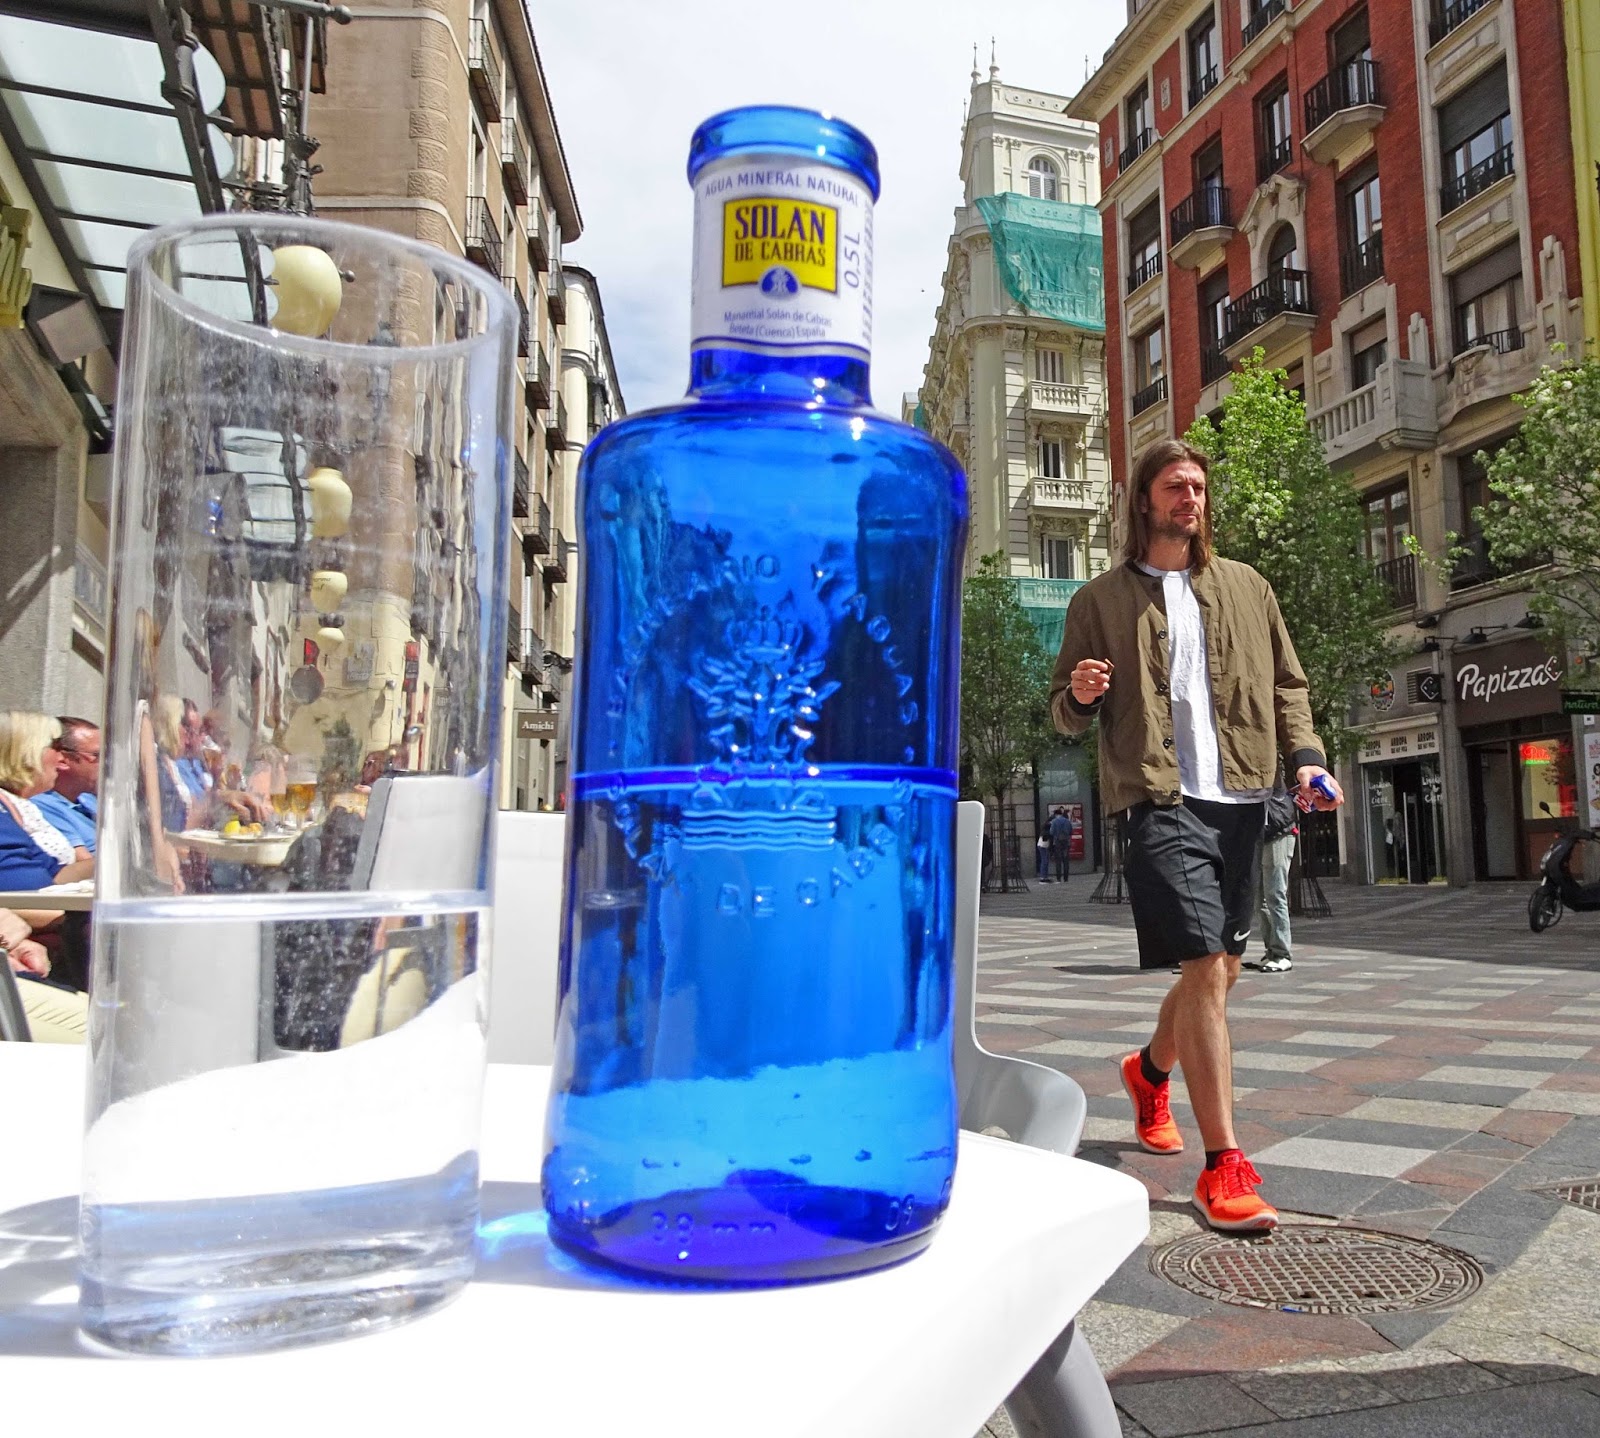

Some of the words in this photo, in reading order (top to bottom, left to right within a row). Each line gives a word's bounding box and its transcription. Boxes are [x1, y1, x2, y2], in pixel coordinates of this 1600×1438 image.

[705, 176, 733, 197] AGUA
[738, 171, 800, 187] MINERAL
[735, 241, 753, 262] DE
[761, 241, 825, 267] CABRAS
[724, 309, 764, 322] Manantial
[793, 309, 804, 321] de
[806, 312, 832, 327] Cabras
[729, 323, 754, 334] Beteta
[755, 324, 794, 337] (Cuenca)
[1456, 663, 1550, 702] Papizza
[521, 721, 554, 730] Amichi
